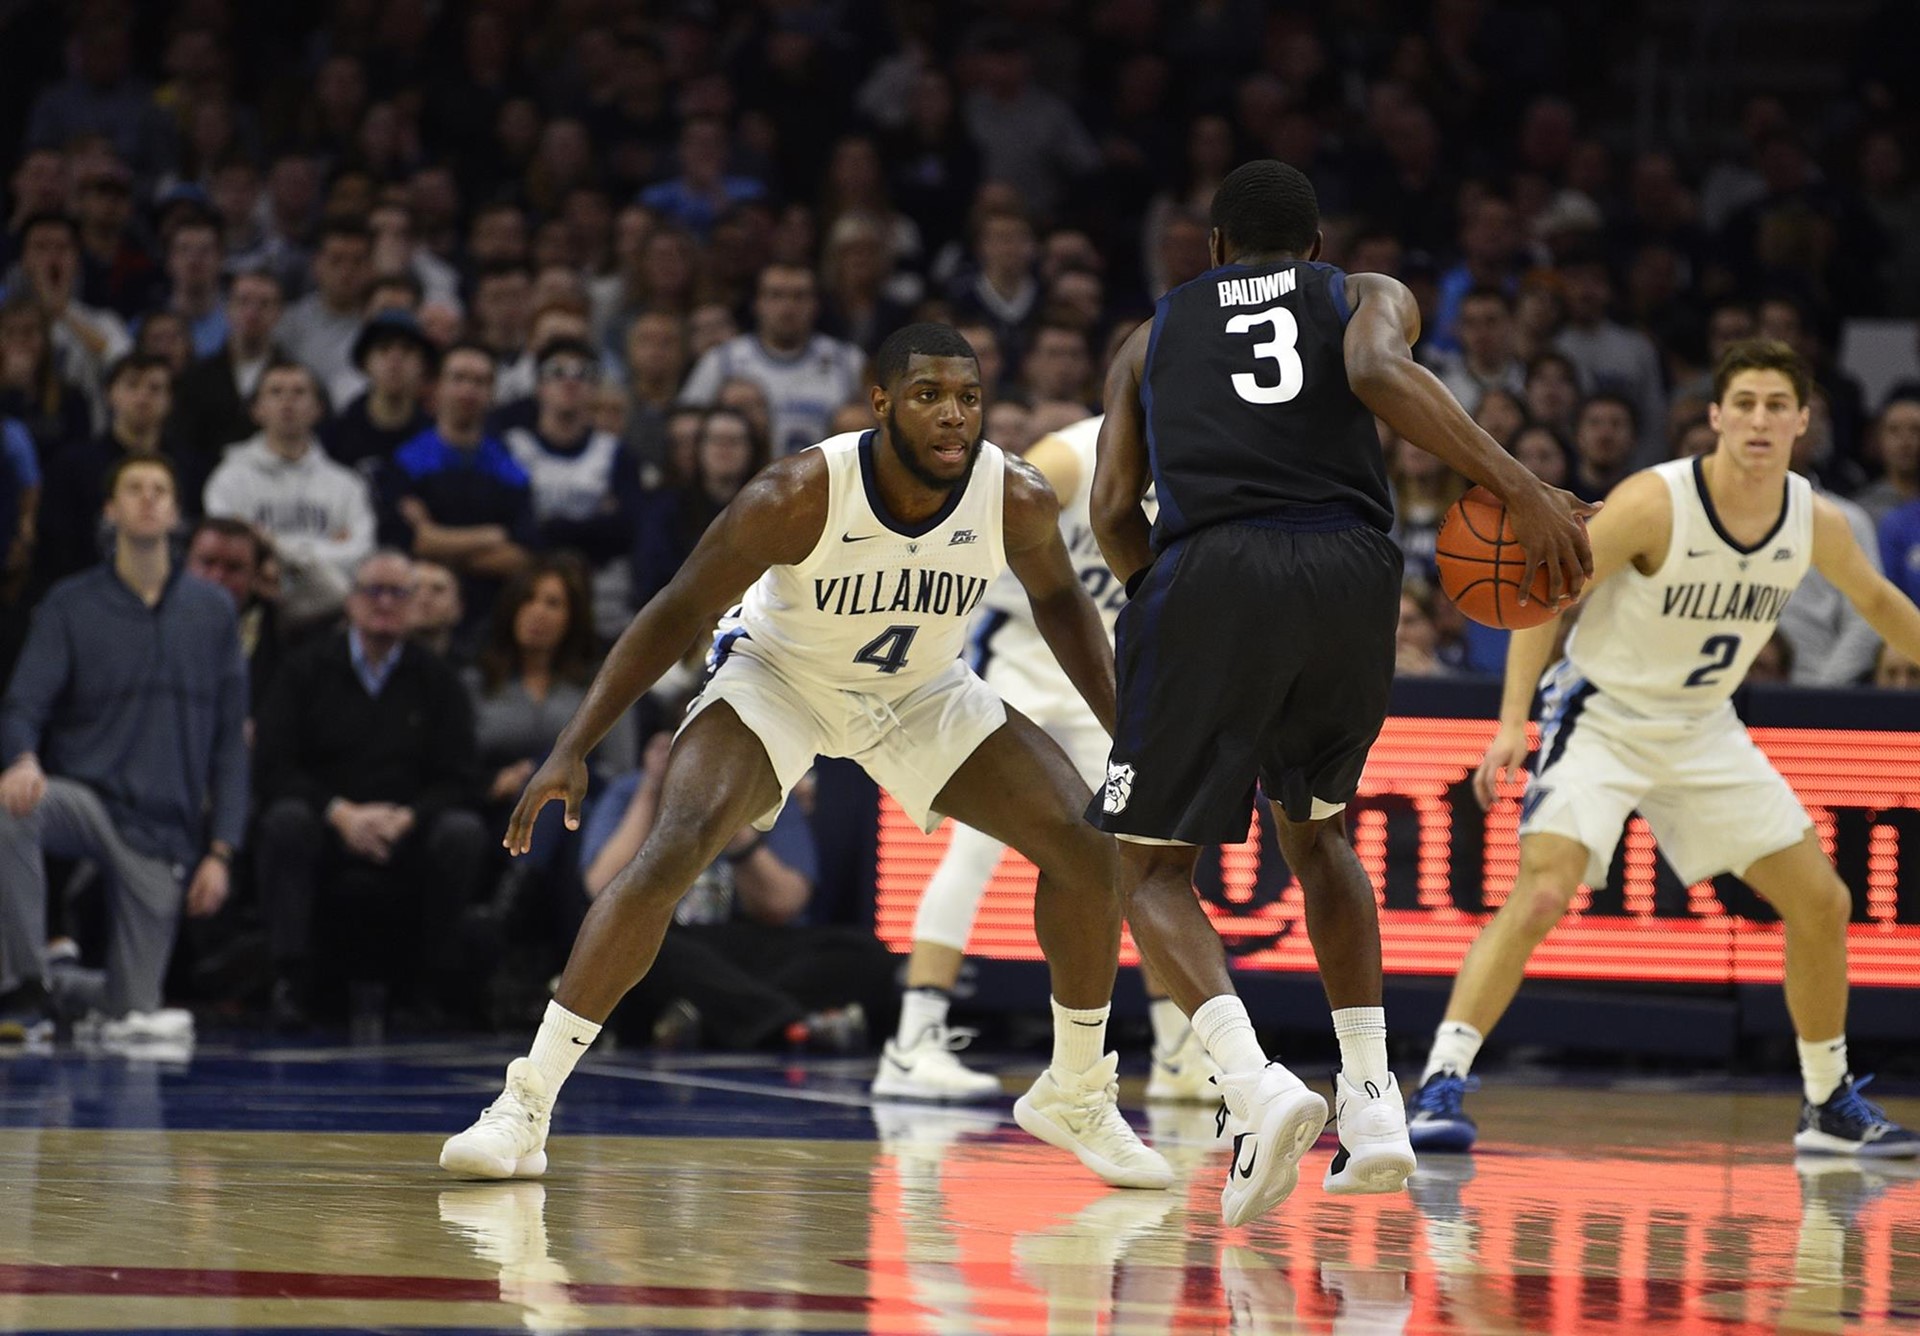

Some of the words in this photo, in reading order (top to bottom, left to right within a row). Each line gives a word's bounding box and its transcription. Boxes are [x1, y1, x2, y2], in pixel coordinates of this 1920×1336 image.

[1217, 267, 1297, 307] BALDWIN
[1225, 306, 1304, 405] 3
[853, 625, 919, 674] 4
[1683, 633, 1741, 687] 2
